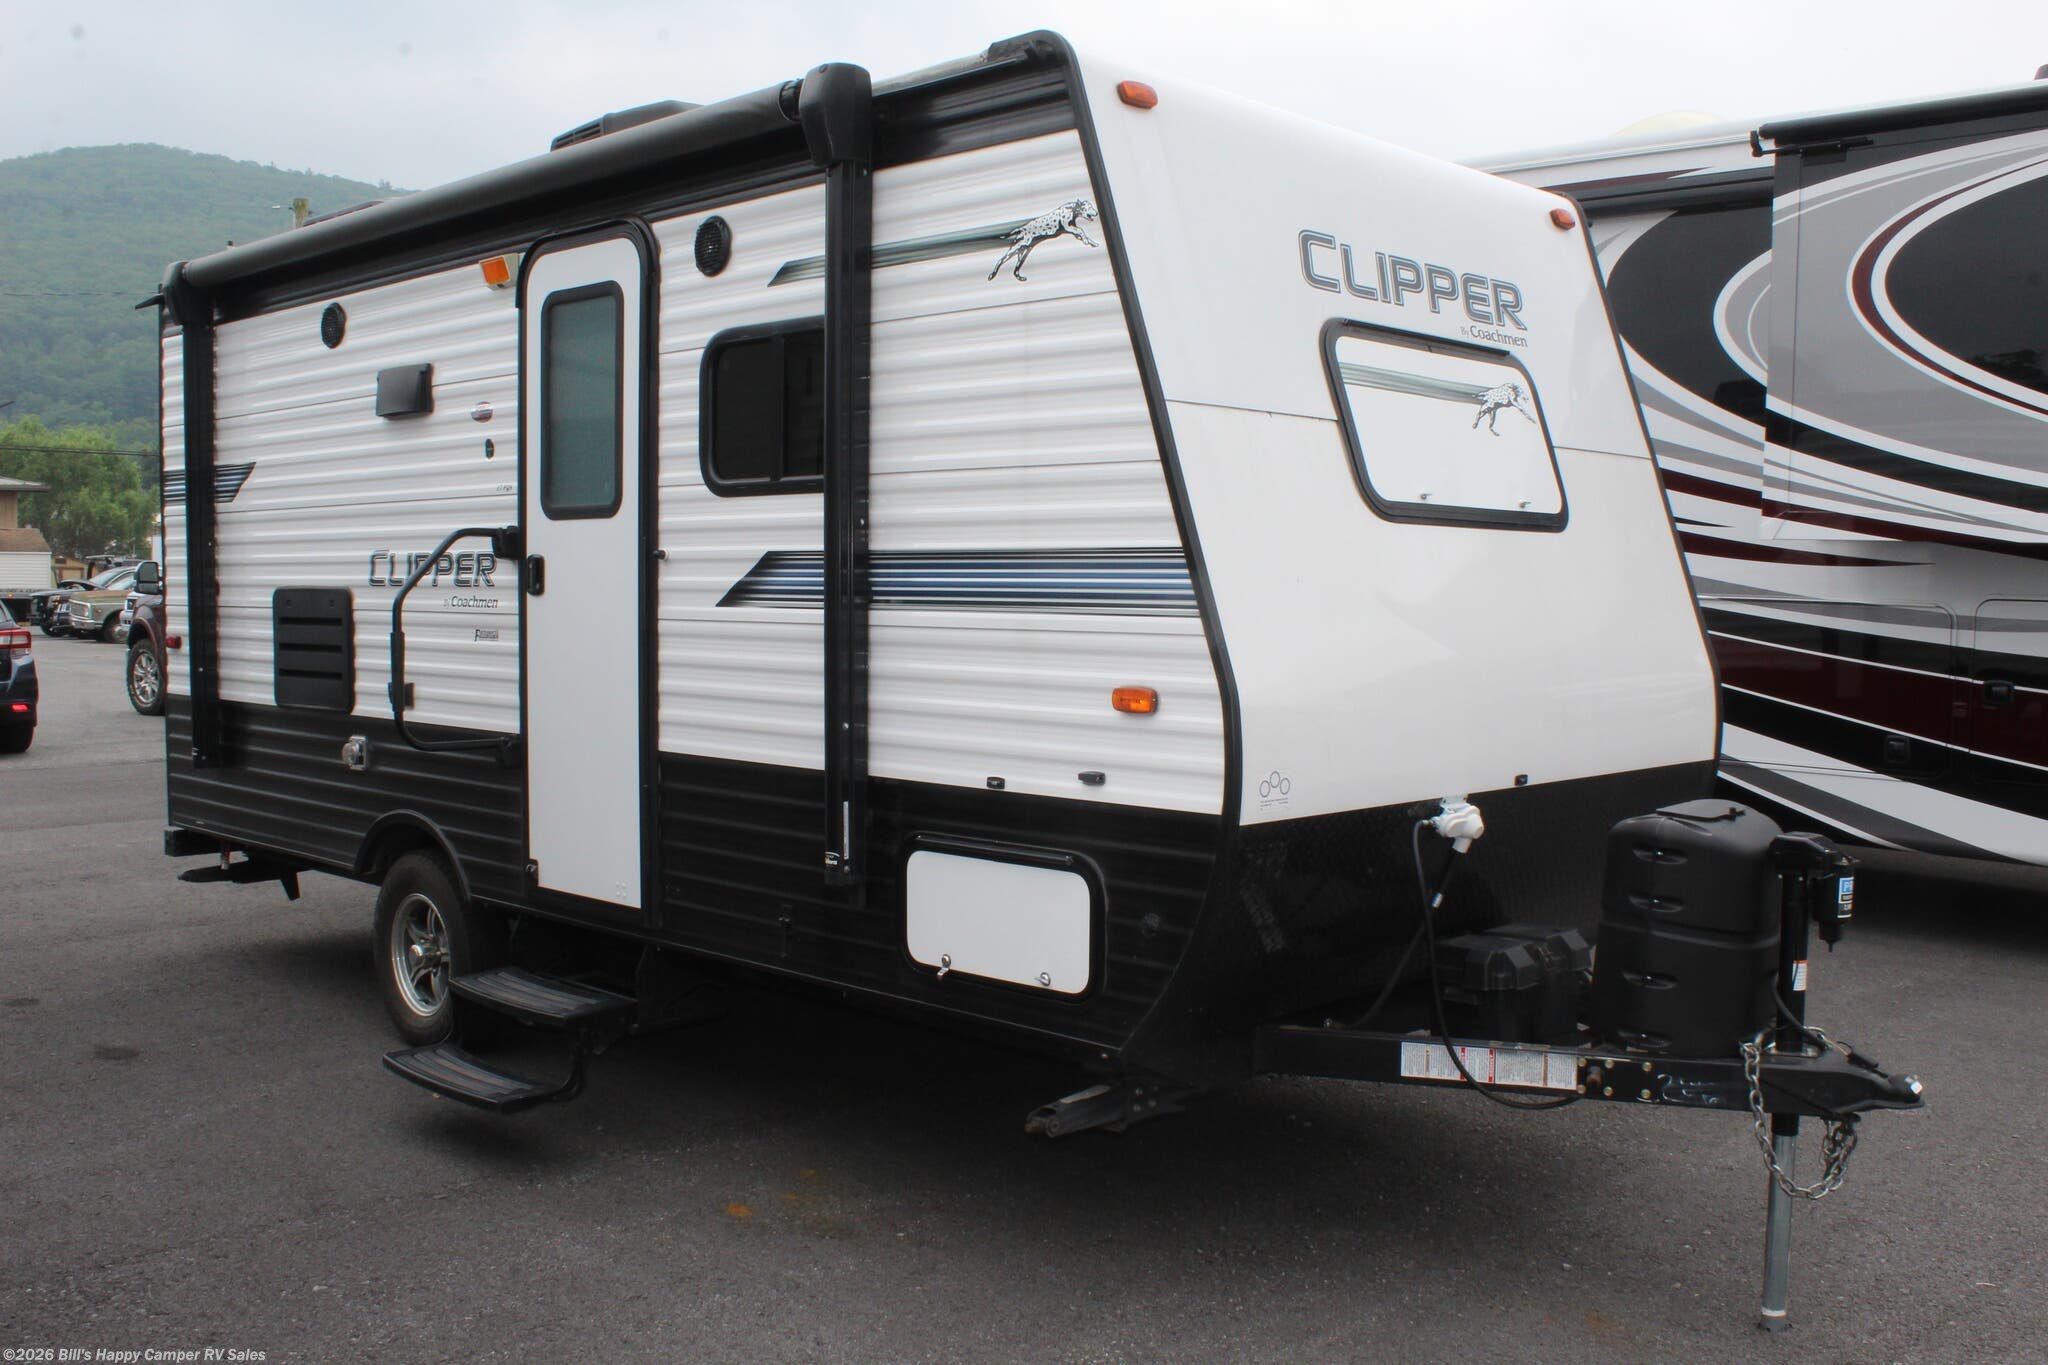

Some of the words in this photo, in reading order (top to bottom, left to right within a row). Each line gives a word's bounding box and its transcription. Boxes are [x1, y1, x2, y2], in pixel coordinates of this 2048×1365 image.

[1298, 229, 1528, 330] CLIPPER
[1470, 325, 1528, 347] Coachmen
[451, 595, 498, 608] Coachmen
